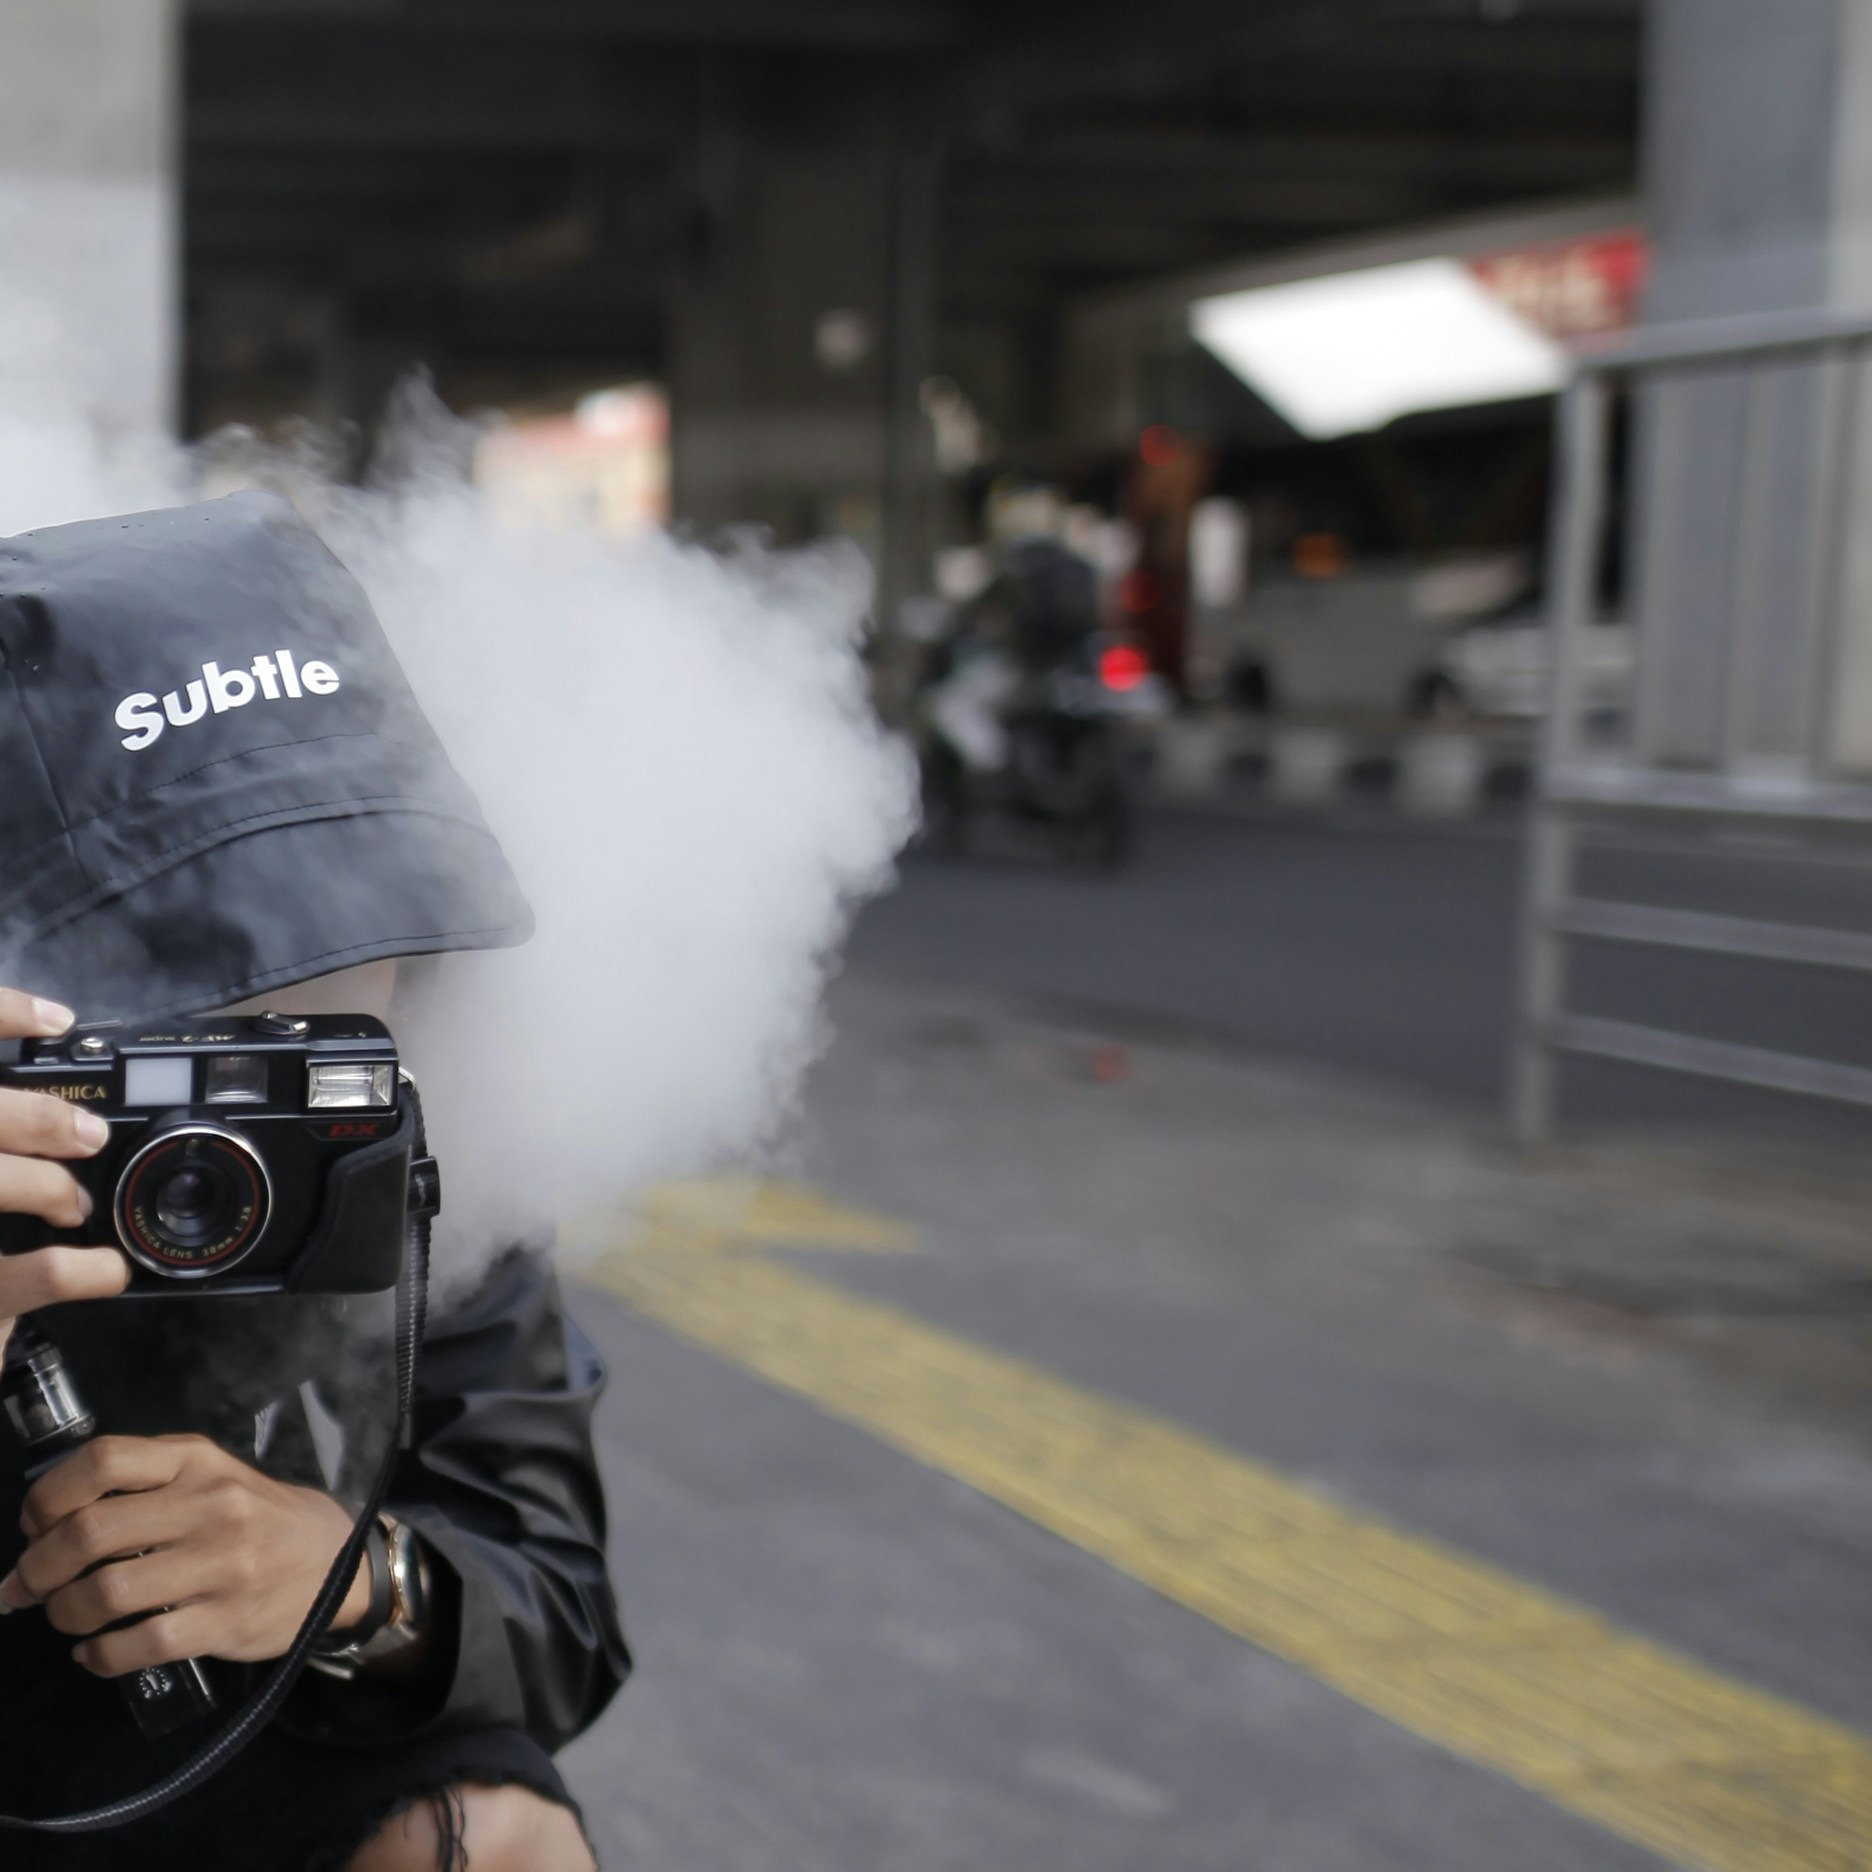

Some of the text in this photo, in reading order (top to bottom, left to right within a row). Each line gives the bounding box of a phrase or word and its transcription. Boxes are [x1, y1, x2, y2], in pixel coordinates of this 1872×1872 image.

[114, 649, 340, 751] Subtle
[329, 1122, 379, 1137] DX
[134, 1206, 160, 1249] YASHICA
[163, 1247, 193, 1259] LENS
